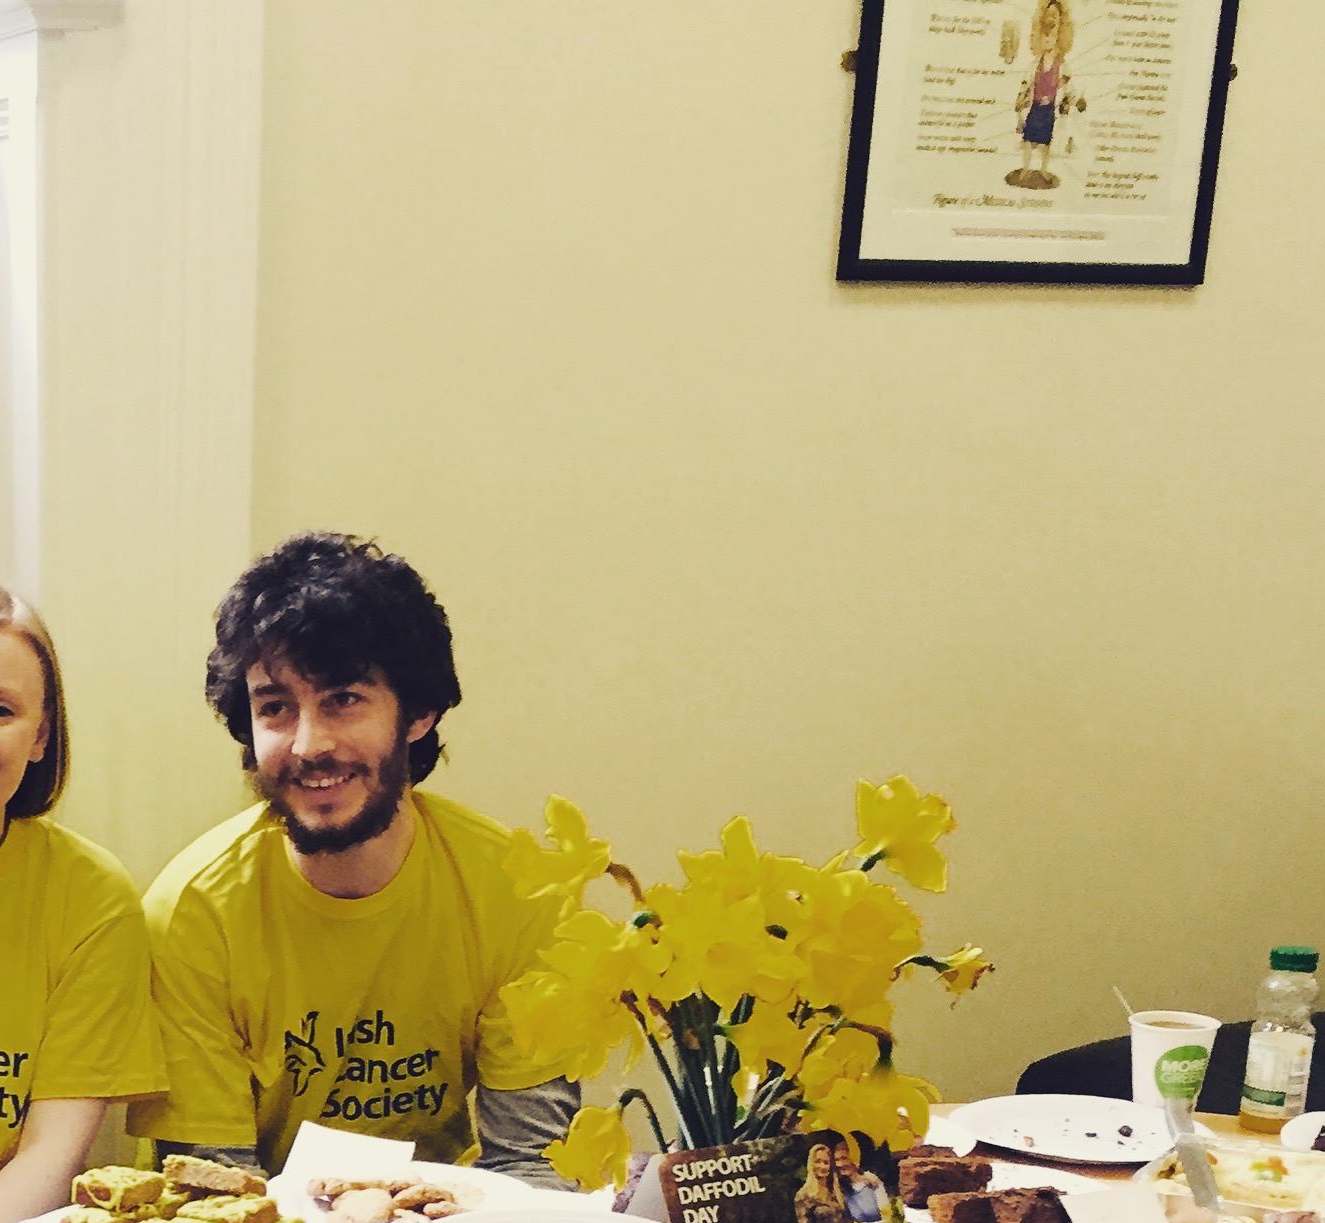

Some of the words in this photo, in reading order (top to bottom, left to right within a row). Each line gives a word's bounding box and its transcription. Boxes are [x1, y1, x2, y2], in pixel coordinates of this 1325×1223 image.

[335, 1047, 439, 1084] ancer
[320, 1082, 449, 1121] Society
[672, 1154, 752, 1183] SUPPORT
[677, 1175, 766, 1205] DAFFODIL
